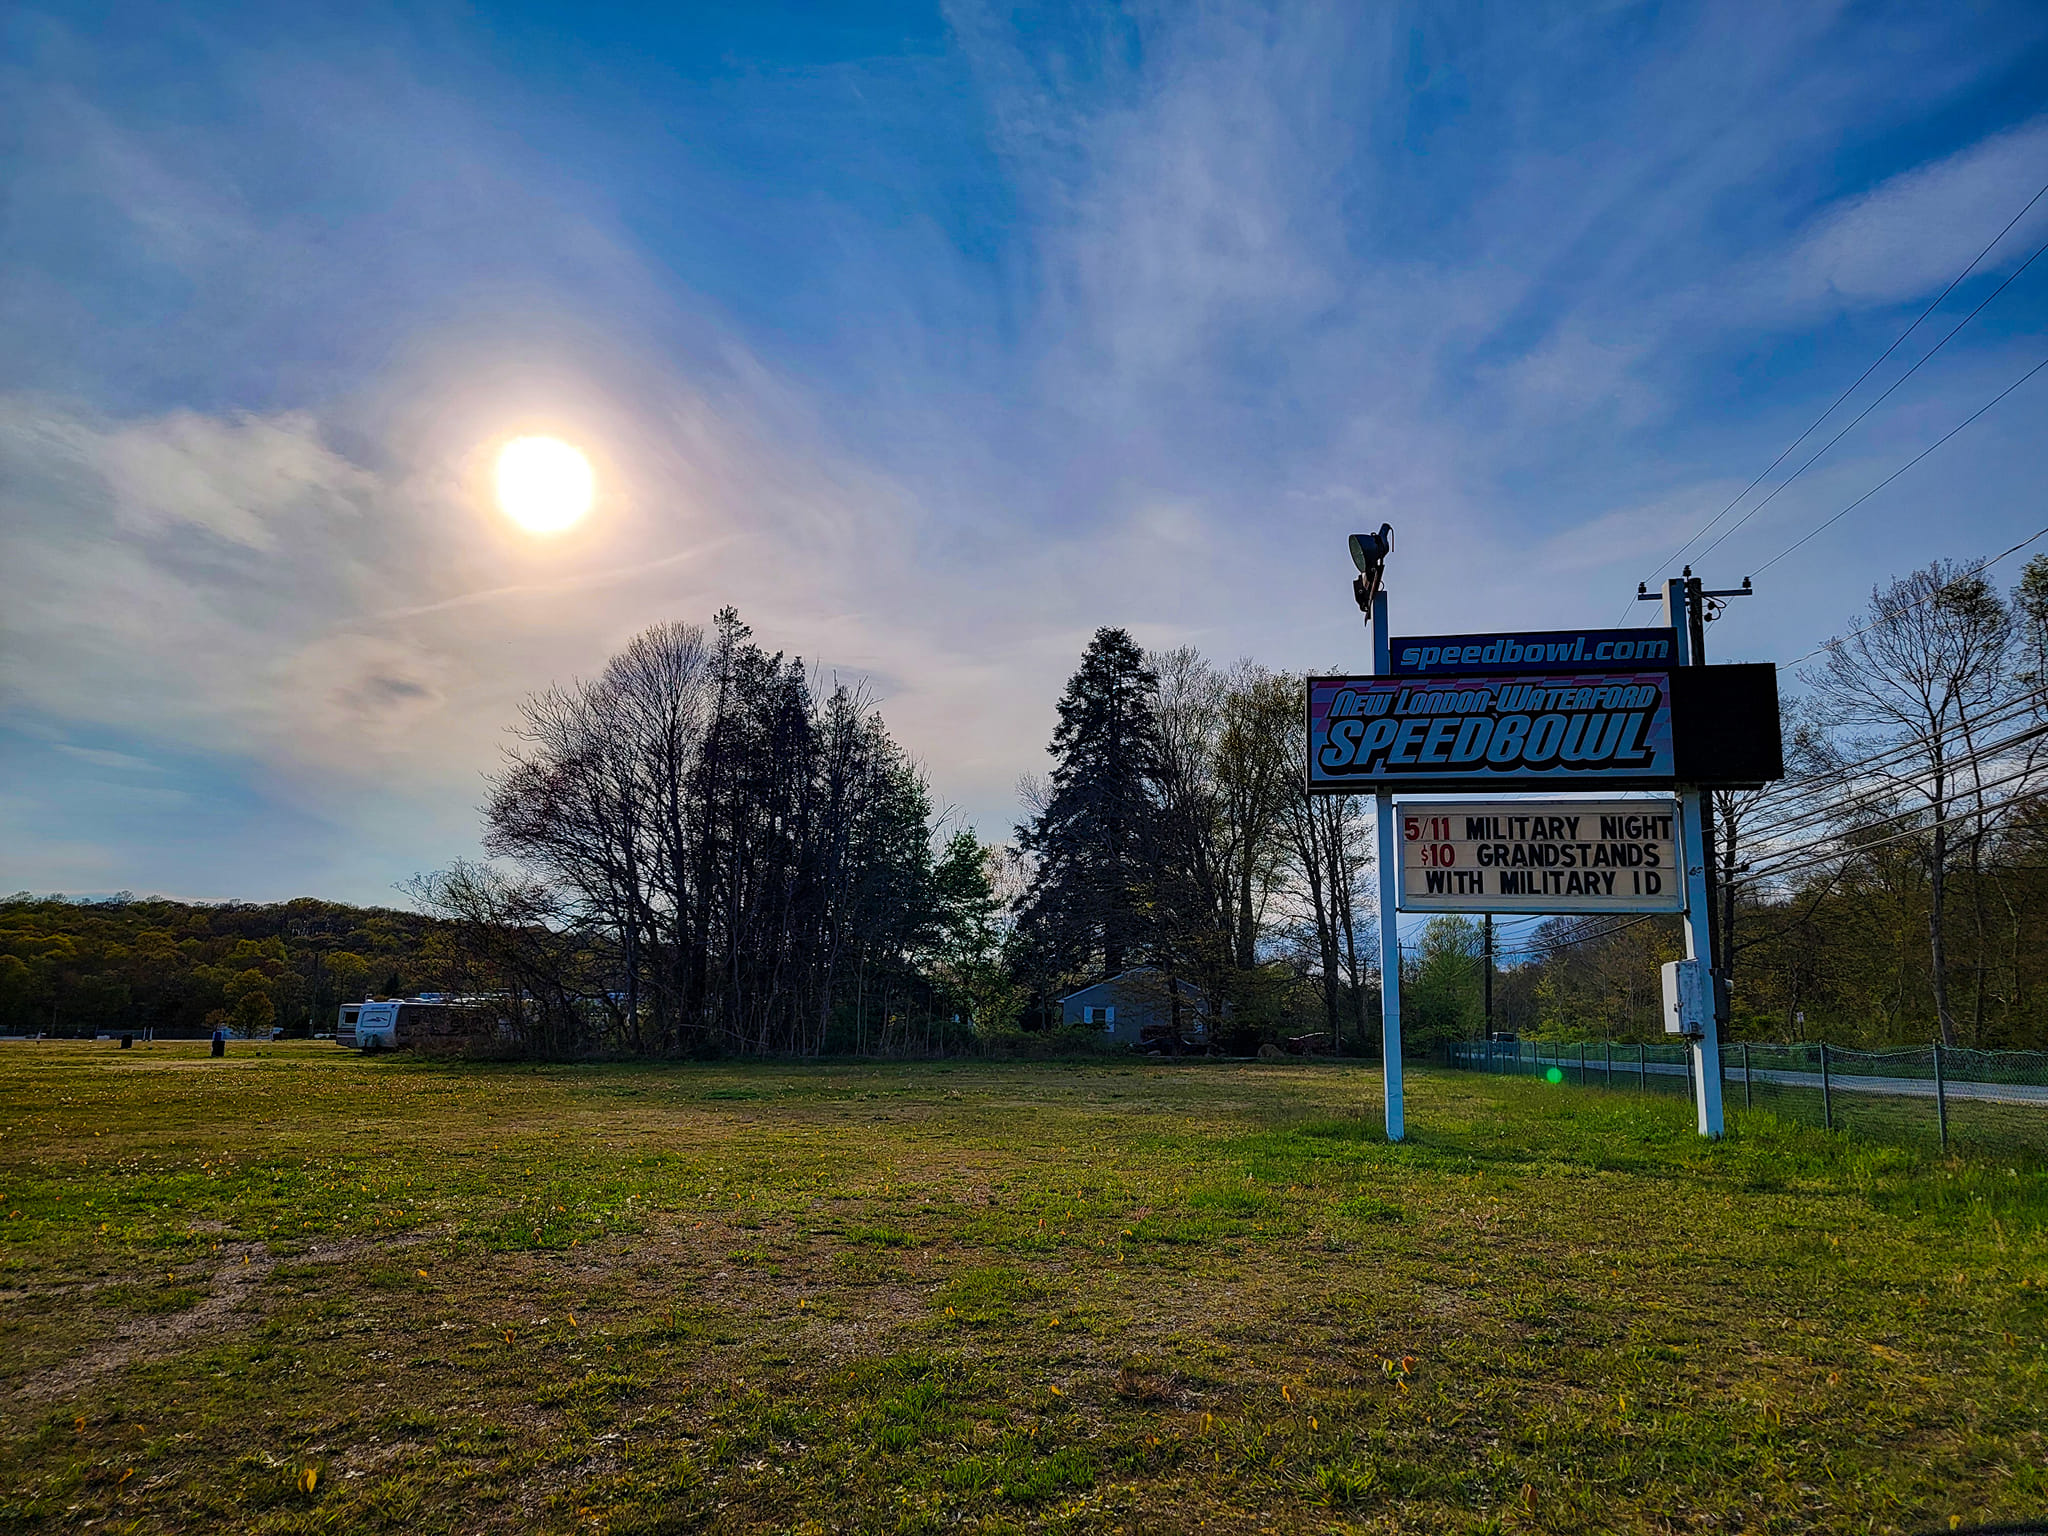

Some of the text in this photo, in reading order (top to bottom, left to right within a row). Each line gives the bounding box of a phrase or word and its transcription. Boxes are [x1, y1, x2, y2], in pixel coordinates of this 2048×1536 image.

[1400, 637, 1669, 670] speedbowl.com
[1321, 712, 1656, 767] SPEEDBOWL
[1404, 815, 1674, 841] 5/11 MILITARY NIGHT
[1421, 843, 1660, 868] $10 GRANDSTANDS
[1425, 870, 1484, 895] WITH
[1500, 870, 1616, 895] MILITARY
[1633, 871, 1661, 895] ID
